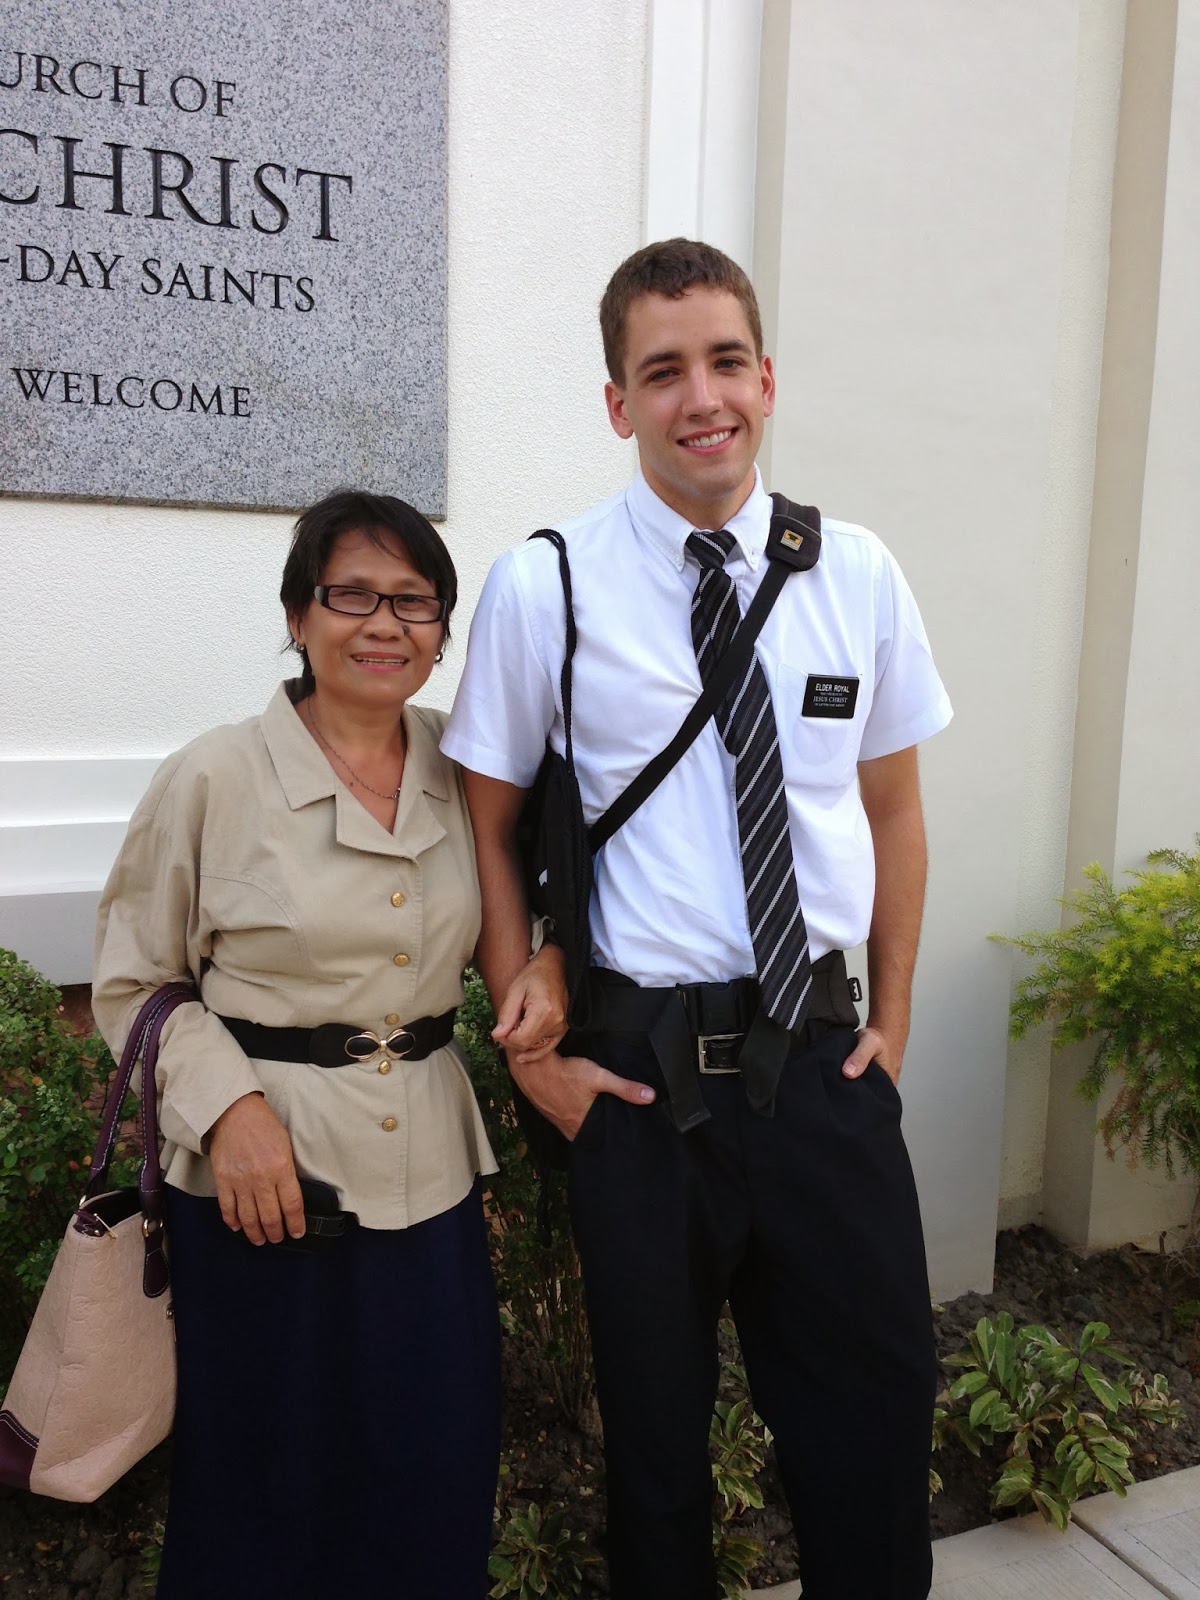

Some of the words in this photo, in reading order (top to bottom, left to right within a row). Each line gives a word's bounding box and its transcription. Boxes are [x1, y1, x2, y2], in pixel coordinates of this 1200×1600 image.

[170, 75, 236, 117] OF
[0, 128, 353, 242] CHRIST
[141, 258, 316, 313] SAINTS
[10, 367, 251, 417] WELCOME
[815, 683, 832, 691] ELDER
[833, 684, 850, 693] ROYAL
